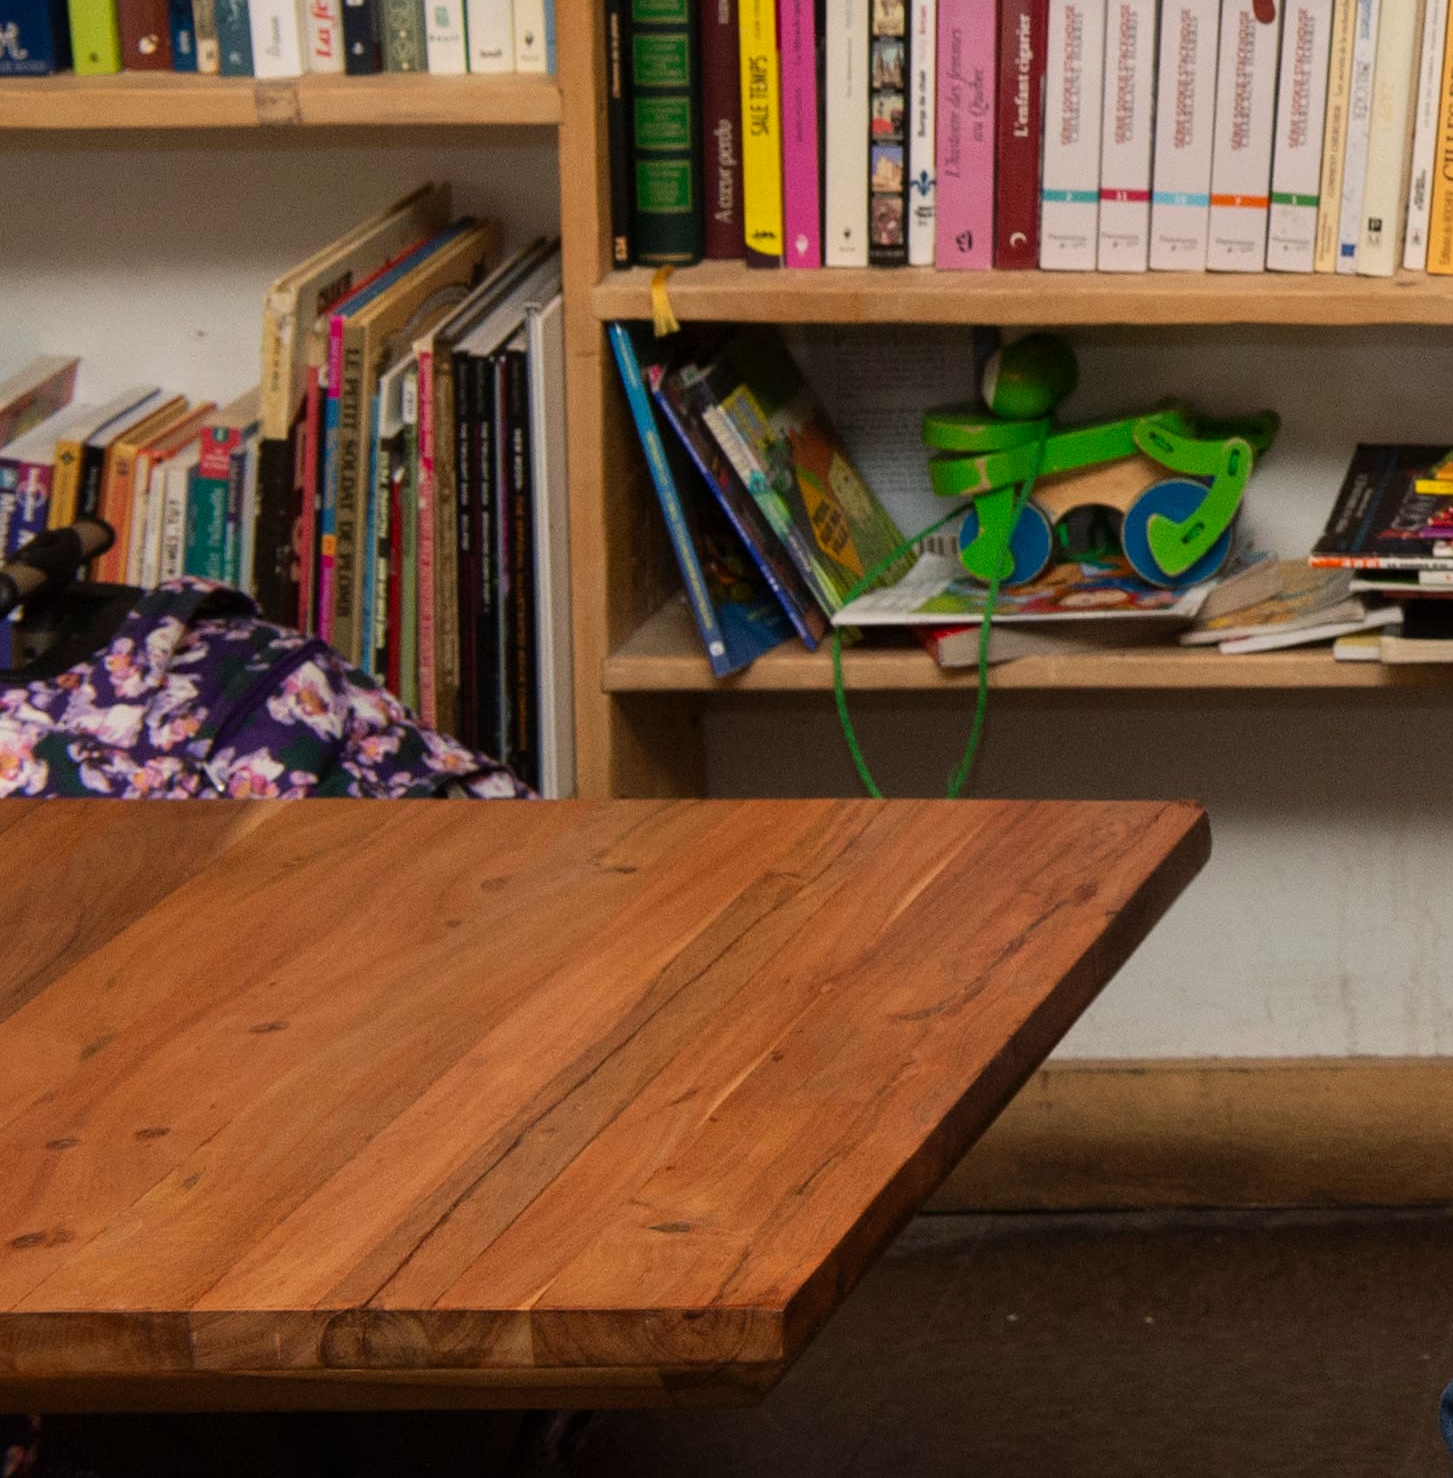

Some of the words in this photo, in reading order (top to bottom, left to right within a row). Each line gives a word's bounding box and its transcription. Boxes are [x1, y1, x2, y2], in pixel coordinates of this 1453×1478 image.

[1015, 14, 1031, 75] cigarier
[749, 56, 769, 99] TEMPS
[751, 104, 770, 136] SALE
[1013, 79, 1029, 137] L'enfant
